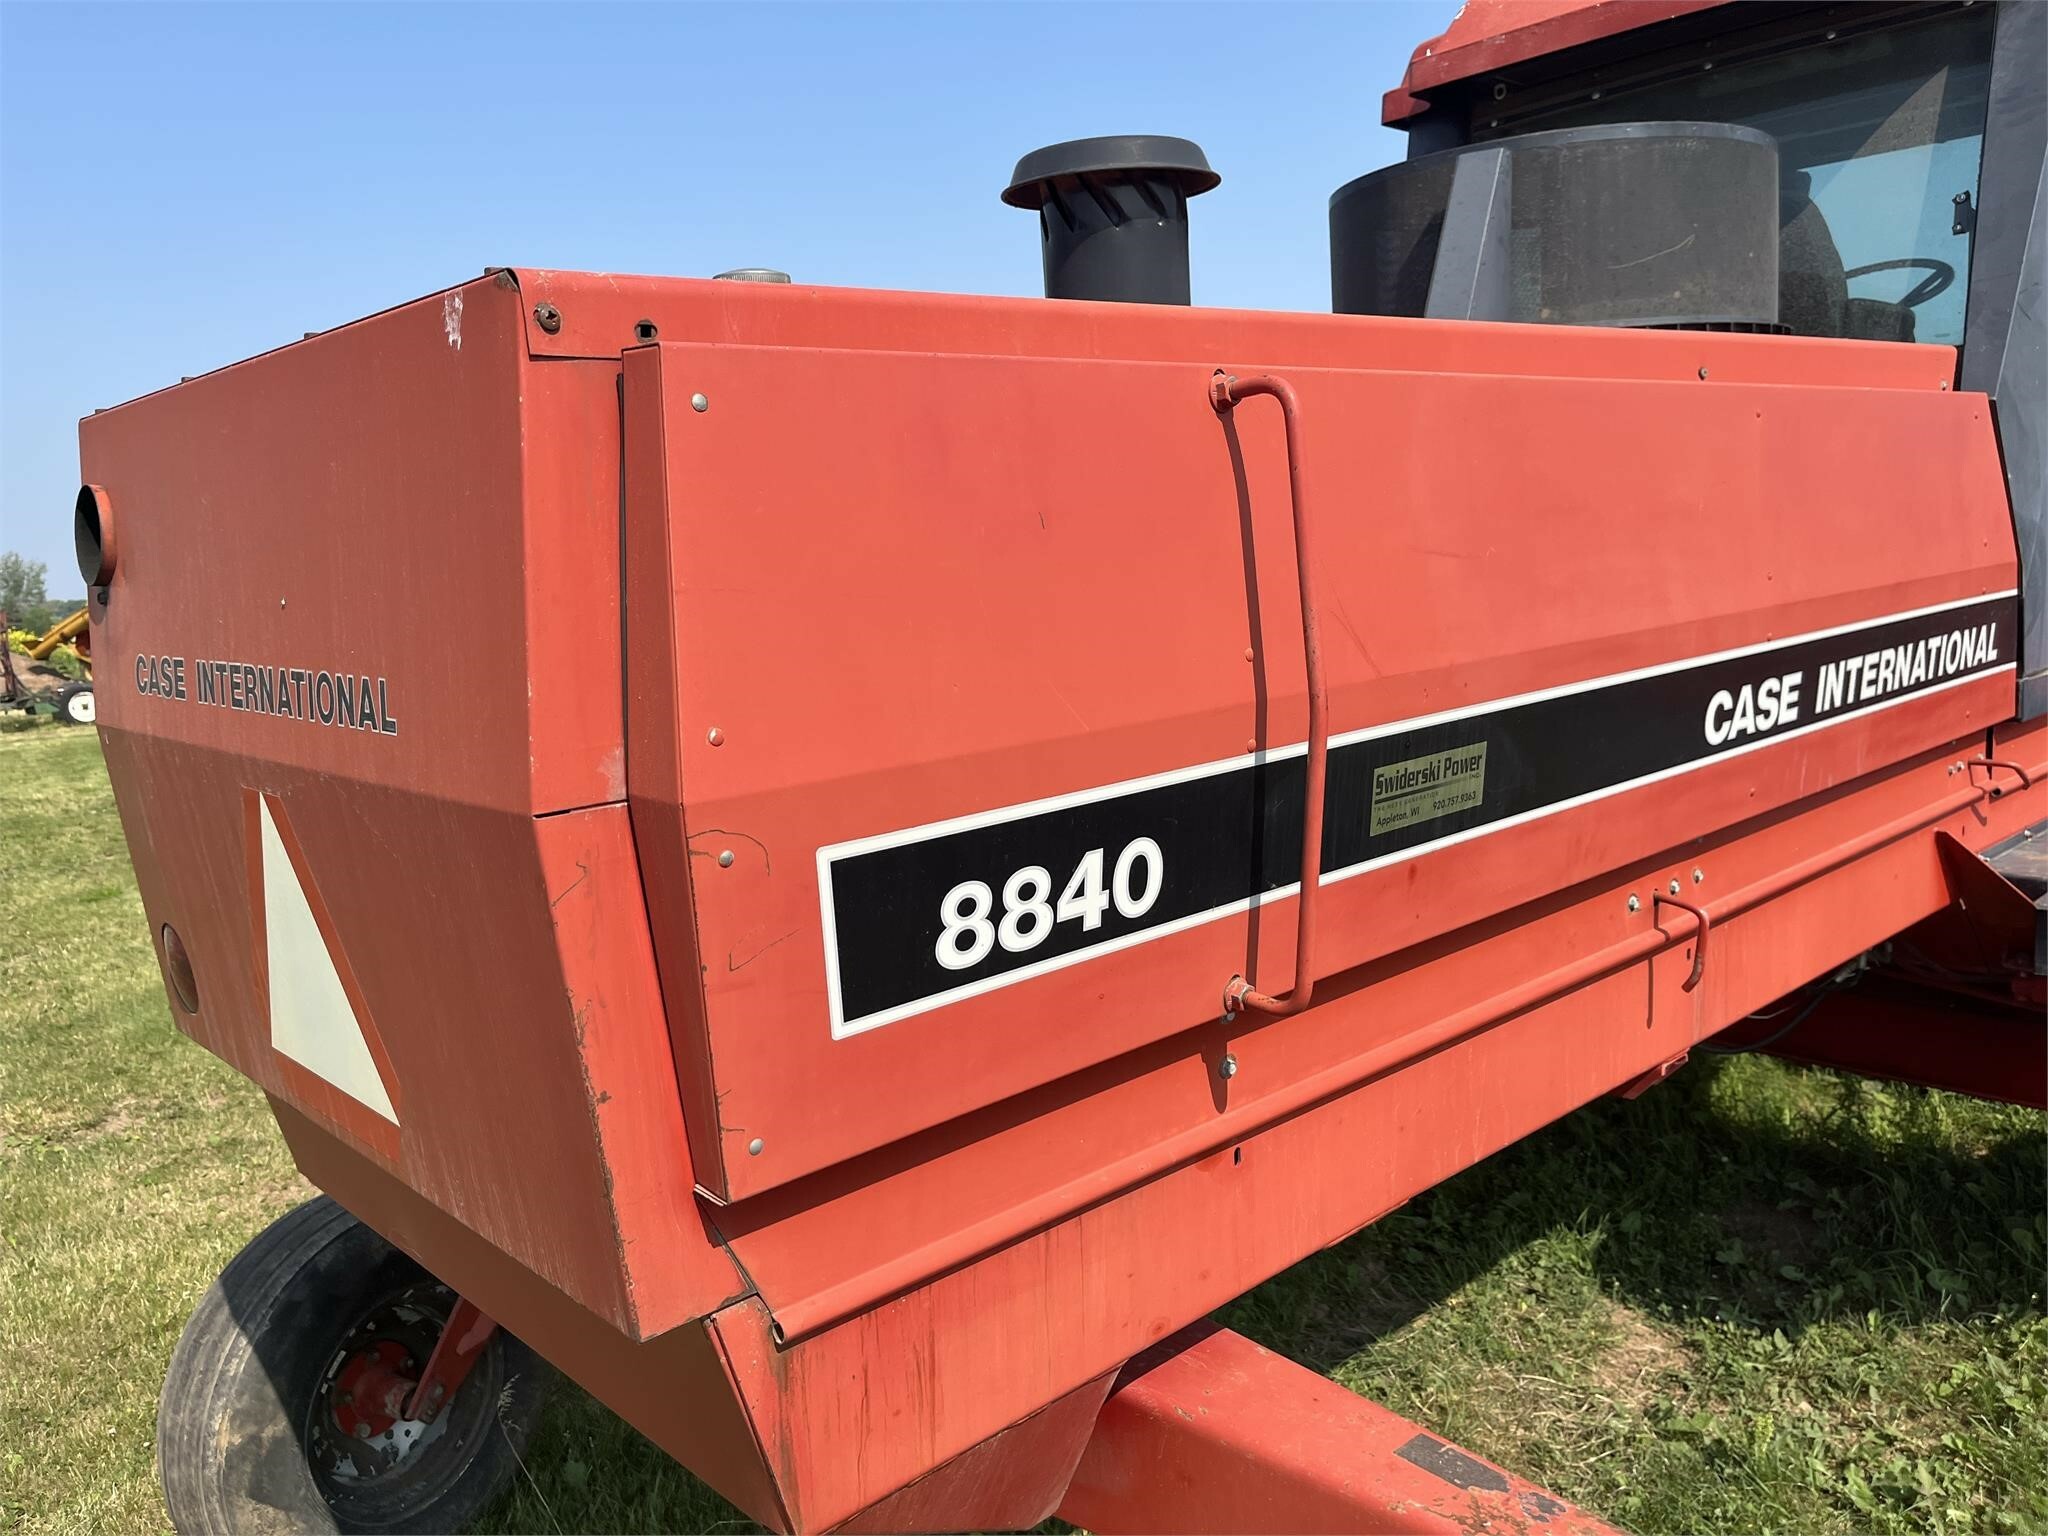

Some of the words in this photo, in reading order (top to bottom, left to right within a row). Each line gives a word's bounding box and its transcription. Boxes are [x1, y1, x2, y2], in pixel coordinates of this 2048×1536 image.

[135, 653, 187, 700] CASE
[195, 659, 398, 736] INTERNATIONAL
[1704, 671, 1803, 746] CASE
[1815, 622, 1998, 714] INTERNATIONAL
[1375, 761, 1440, 796] Swiderski
[1443, 755, 1482, 778] Power
[1376, 812, 1409, 827] Appleton,
[1410, 806, 1419, 816] WI
[1433, 791, 1476, 811] 920.757.9363
[935, 836, 1164, 970] 8840
